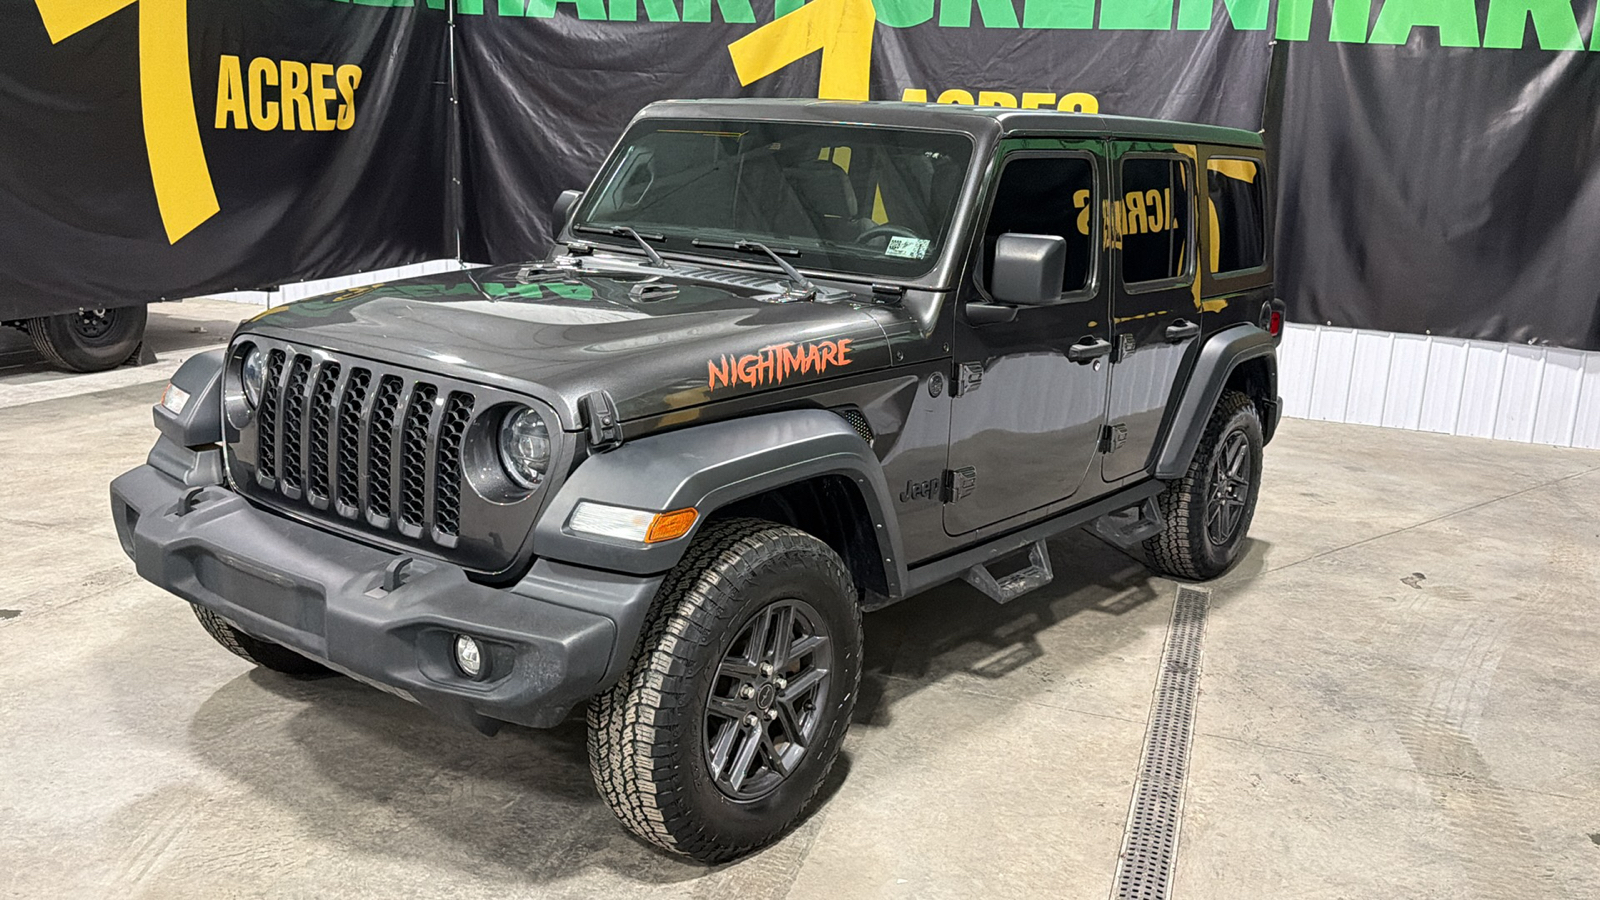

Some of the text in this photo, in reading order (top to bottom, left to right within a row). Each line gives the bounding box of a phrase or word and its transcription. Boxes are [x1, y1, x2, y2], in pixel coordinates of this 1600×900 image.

[214, 54, 363, 132] ACRES
[707, 338, 854, 393] NIGHTMARE
[899, 477, 940, 503] Jeep
